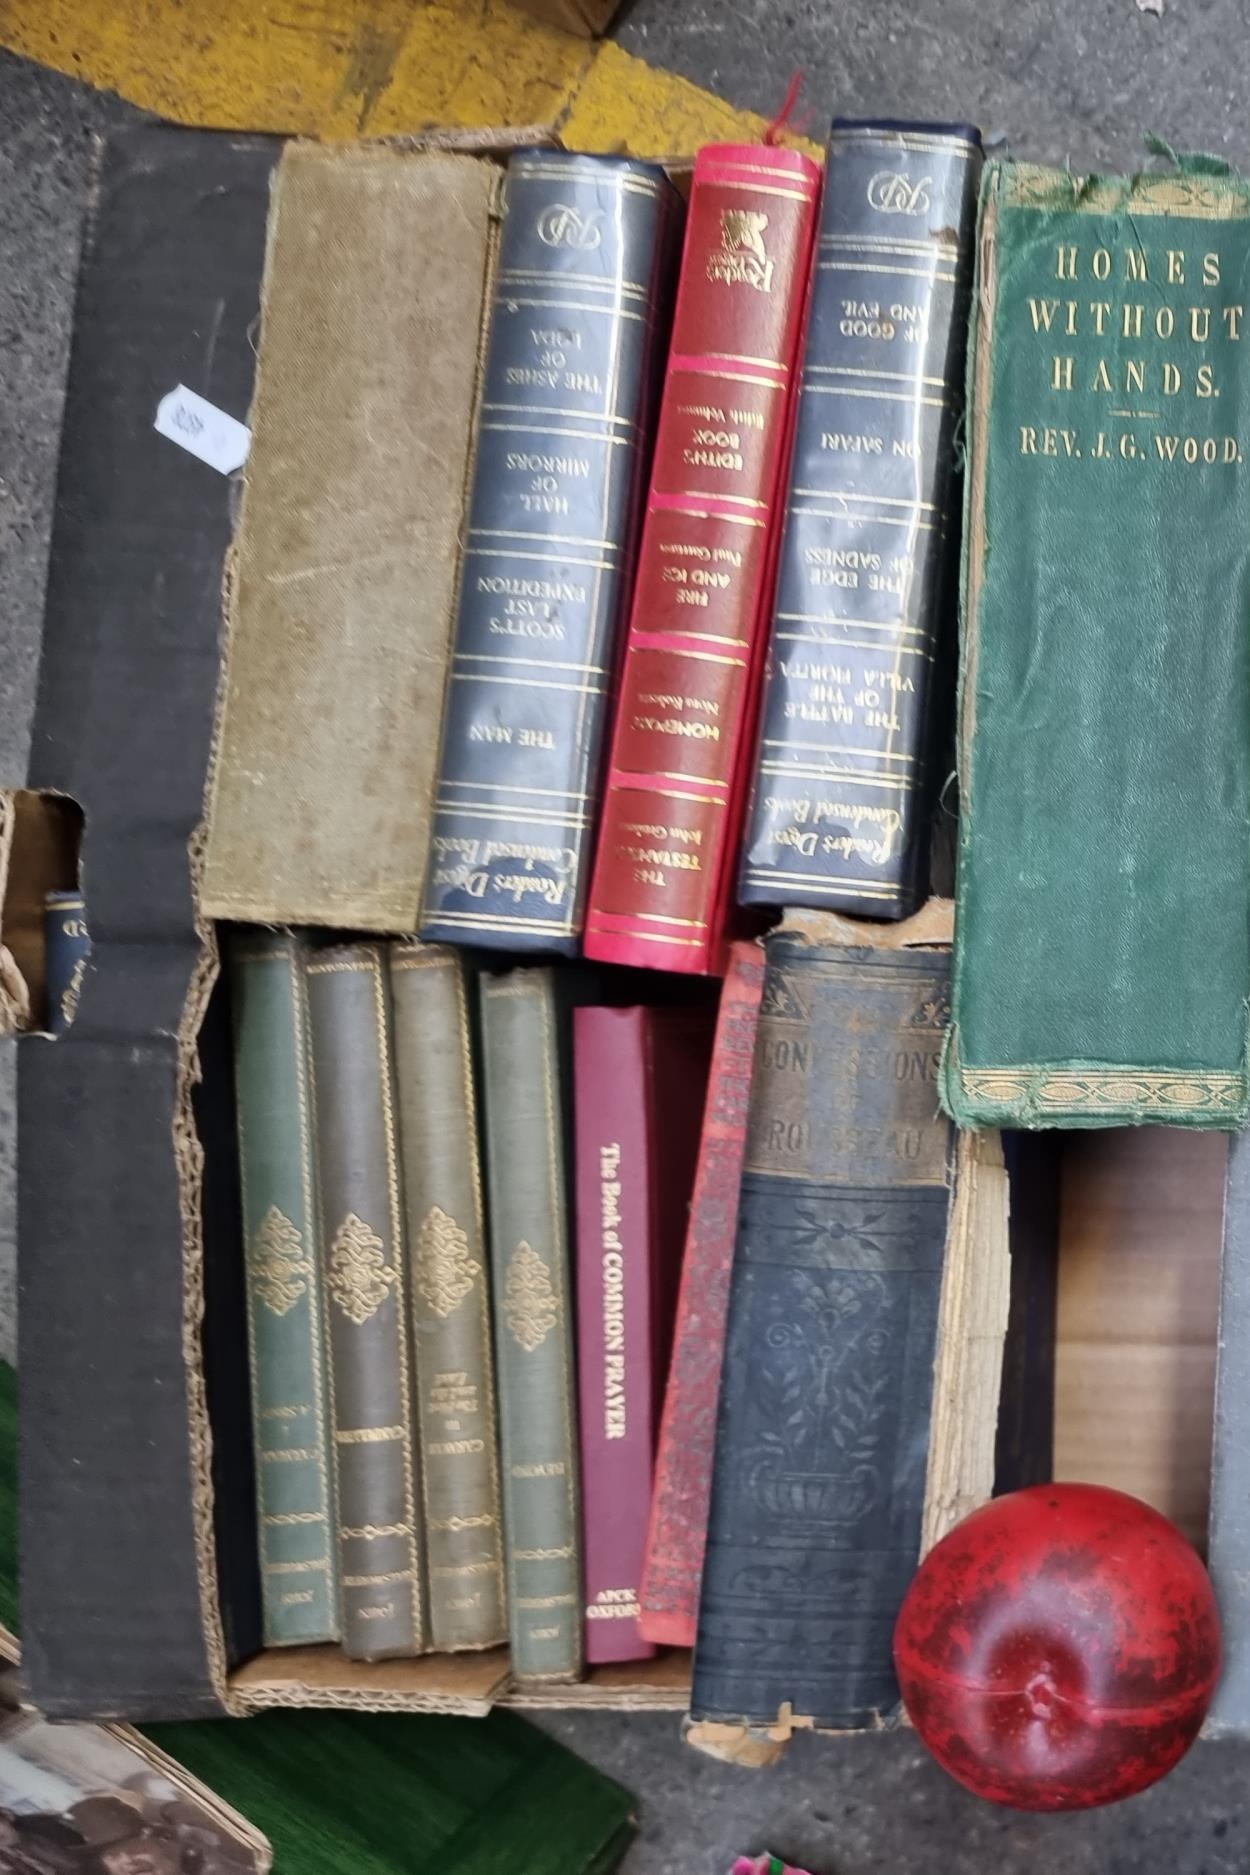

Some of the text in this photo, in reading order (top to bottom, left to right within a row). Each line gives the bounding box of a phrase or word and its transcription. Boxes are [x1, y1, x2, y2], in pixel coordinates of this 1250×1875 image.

[1055, 246, 1220, 286] HOMES
[841, 298, 880, 320] EVIL
[1026, 298, 1242, 342] WITHOUT
[839, 319, 894, 341] GOOD
[542, 349, 566, 367] OF
[564, 371, 602, 392] THE
[1051, 356, 1220, 398] HANDS.
[821, 432, 883, 455] SAFARI
[1020, 425, 1081, 457] REV.
[1155, 435, 1242, 463] WOOD.
[506, 453, 590, 479] MIRRORS
[532, 474, 558, 494] OF
[520, 495, 569, 513] HALL
[804, 547, 881, 572] SADNESS
[477, 576, 586, 602] EXPEDITION
[809, 568, 858, 590] EDGE
[504, 599, 551, 621] LAST
[469, 723, 556, 750] THE MAN
[600, 1142, 626, 1440] The Book of COMMON PRAYER
